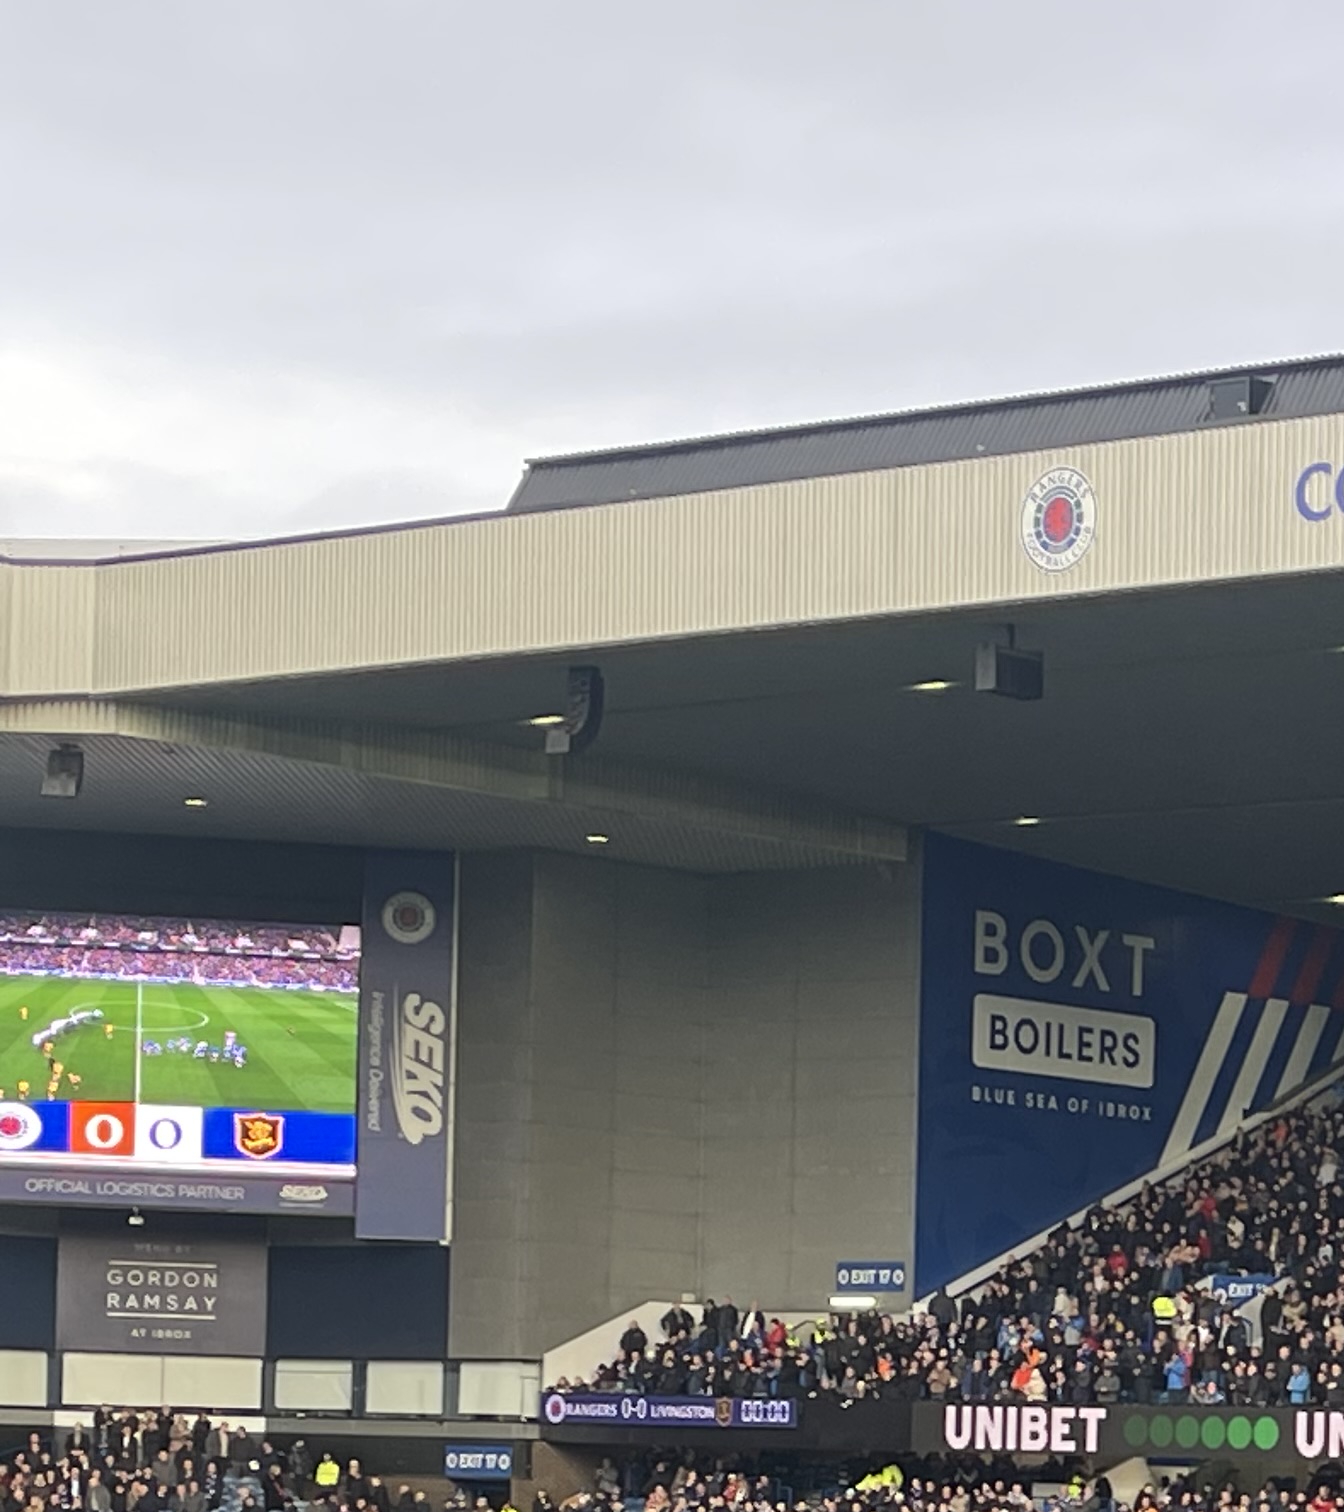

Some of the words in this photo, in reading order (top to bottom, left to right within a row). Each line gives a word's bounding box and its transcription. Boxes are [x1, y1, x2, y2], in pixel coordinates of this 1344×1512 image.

[973, 909, 1156, 997] BOXT
[988, 1014, 1142, 1071] BOILERS
[403, 993, 446, 1145] SEKO
[972, 1086, 1016, 1106] BLUE
[1026, 1092, 1058, 1112] SEA
[1067, 1098, 1089, 1115] OF
[1098, 1101, 1153, 1122] IBROX
[85, 1114, 123, 1148] 0
[150, 1118, 182, 1150] 0
[25, 1179, 92, 1196] OFFICIAL
[96, 1181, 175, 1198] LOGISTICS
[179, 1183, 244, 1200] PARTNER
[107, 1269, 218, 1288] GORDON
[107, 1293, 217, 1311] RAMSAY
[131, 1328, 146, 1338] AT
[565, 1401, 618, 1417] RANGERS
[650, 1404, 715, 1419] LIVINGSTON
[944, 1406, 1106, 1452] UNIBET
